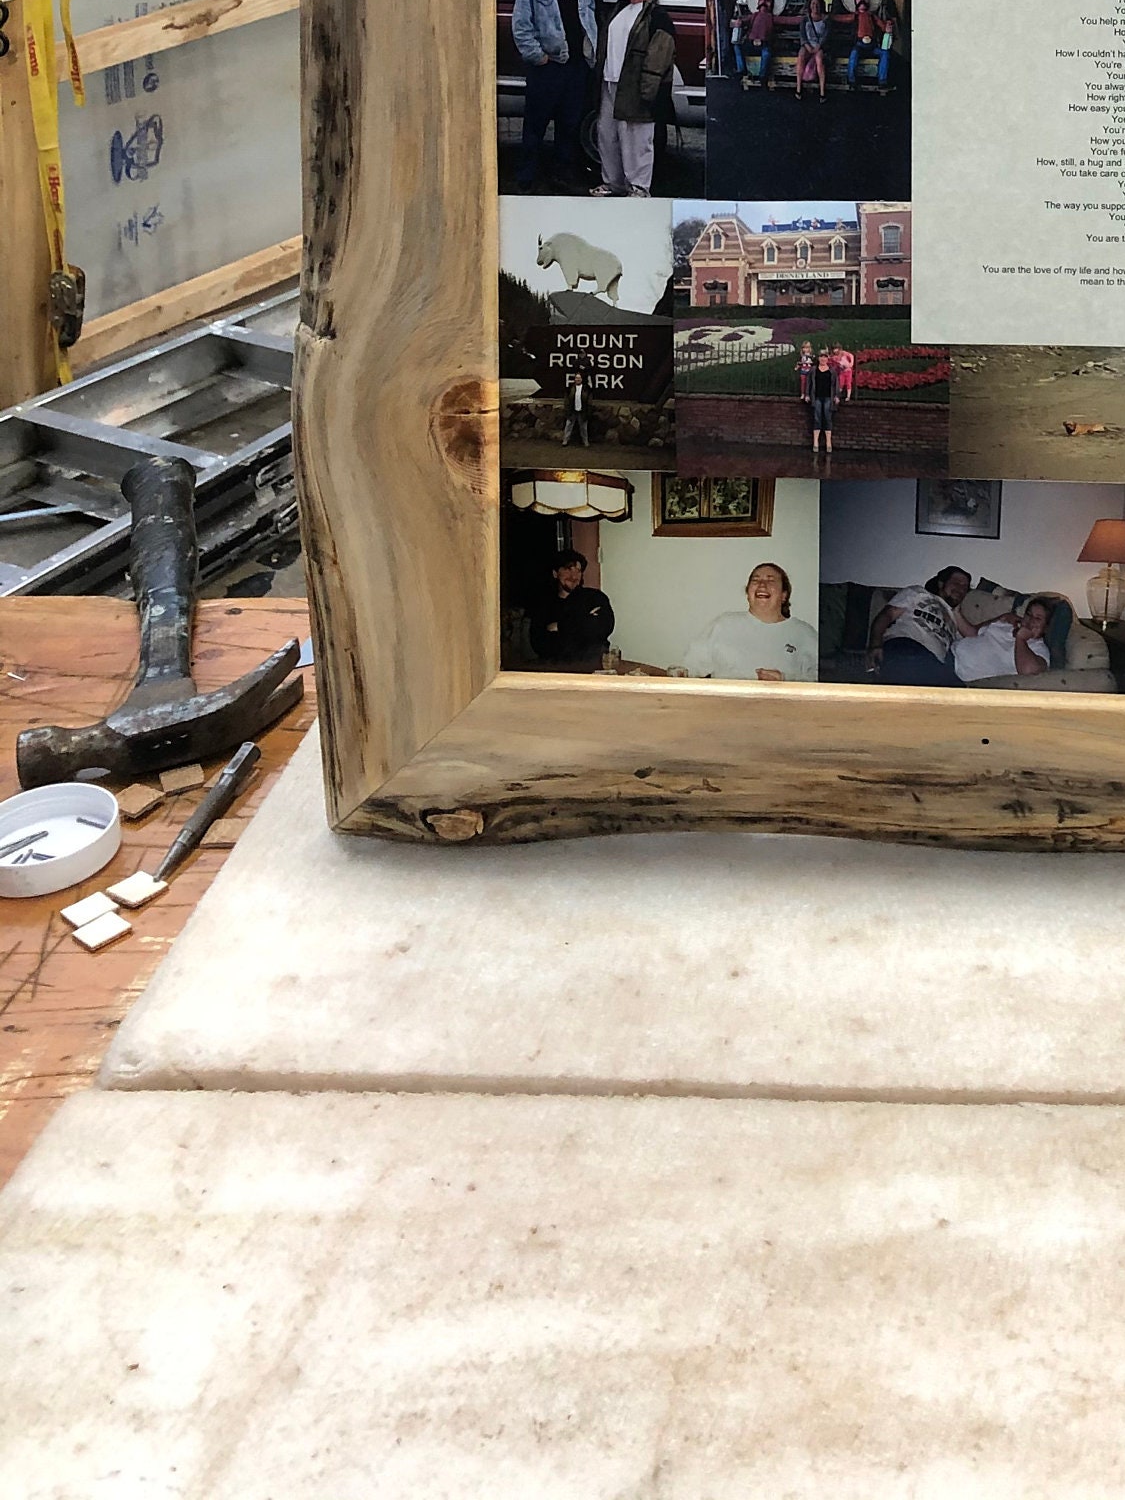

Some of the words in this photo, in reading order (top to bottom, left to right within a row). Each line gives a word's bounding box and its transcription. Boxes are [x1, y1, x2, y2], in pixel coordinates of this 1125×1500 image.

[1055, 49, 1075, 57] How
[1077, 49, 1080, 57] I
[1082, 49, 1115, 58] couldn't
[1087, 92, 1106, 101] How
[1068, 103, 1088, 112] How
[1090, 105, 1110, 114] easy
[1090, 136, 1110, 144] How
[1044, 200, 1061, 209] The
[1063, 202, 1081, 211] way
[1082, 203, 1099, 211] you
[776, 271, 829, 279] DISNEYLAND
[1106, 277, 1115, 286] to
[557, 333, 638, 349] MOUNT
